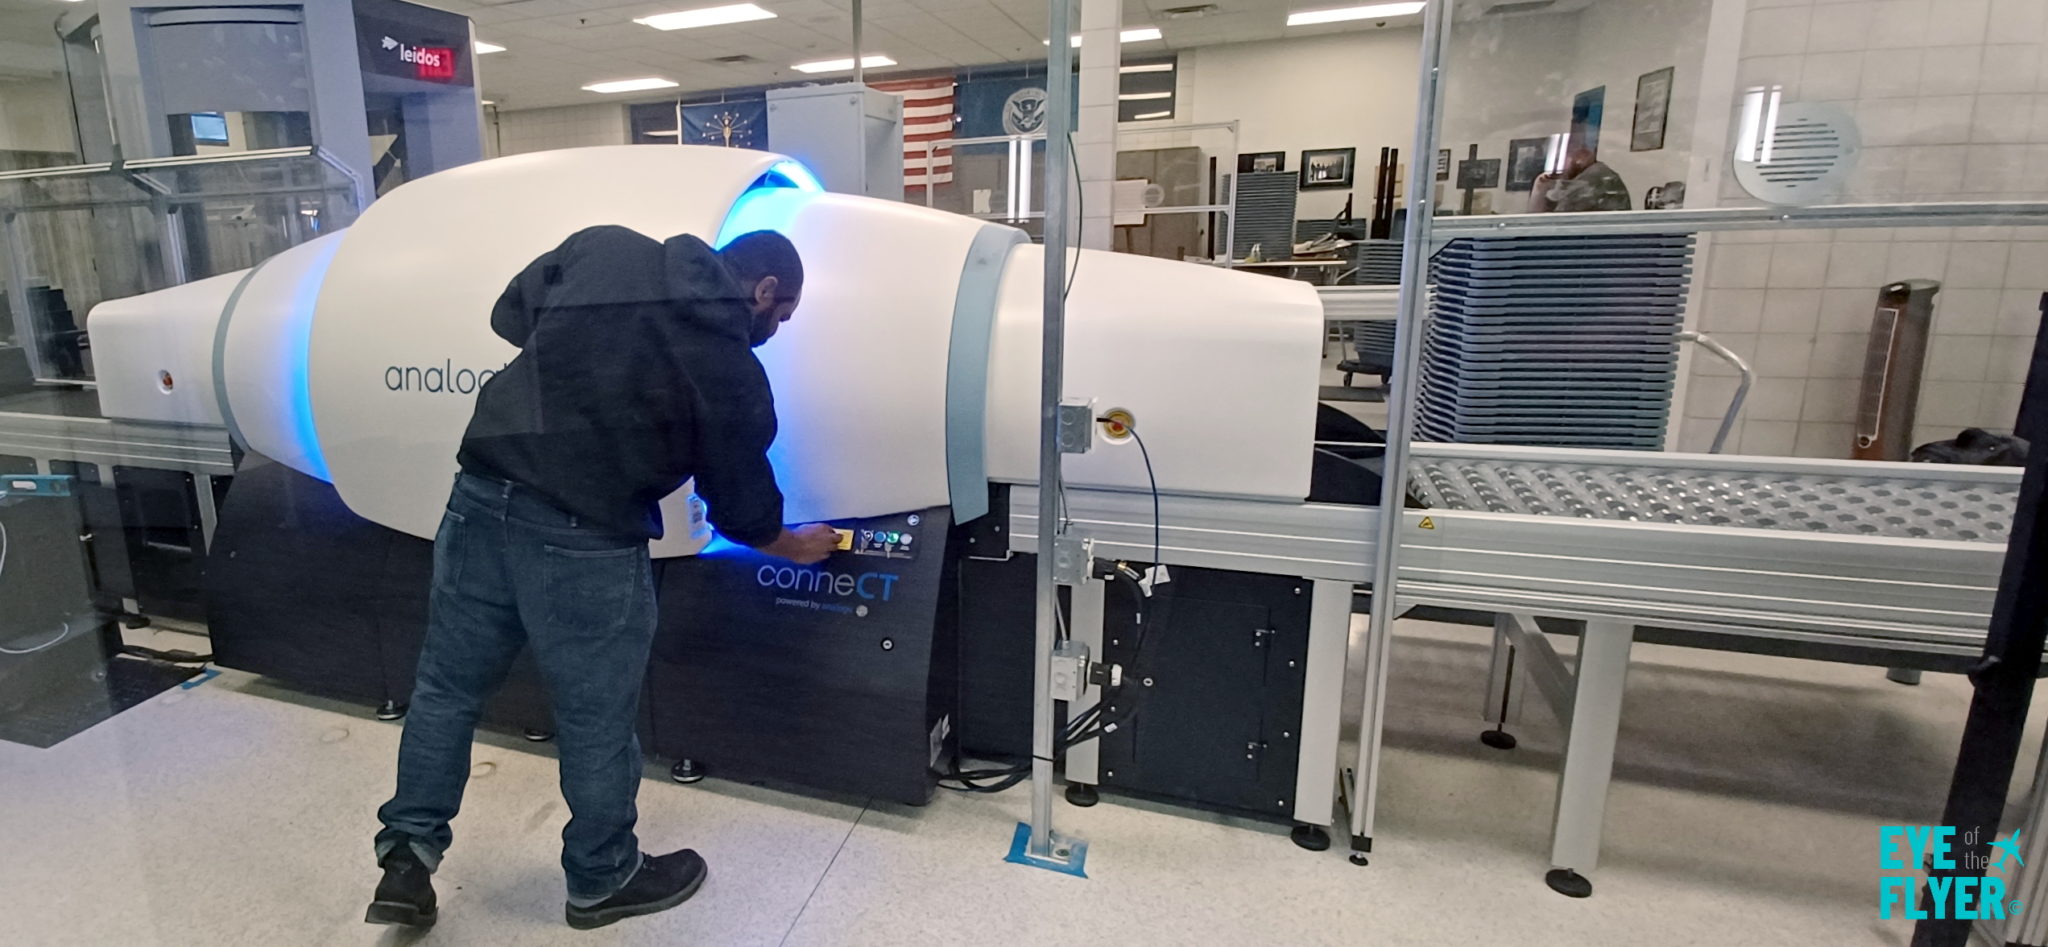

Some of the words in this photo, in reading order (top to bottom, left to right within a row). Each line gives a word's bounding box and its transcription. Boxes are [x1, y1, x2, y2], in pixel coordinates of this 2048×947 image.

[400, 43, 441, 67] leidos
[385, 358, 507, 395] analo
[757, 564, 899, 601] conneCT
[775, 597, 810, 608] powered
[810, 600, 821, 610] by
